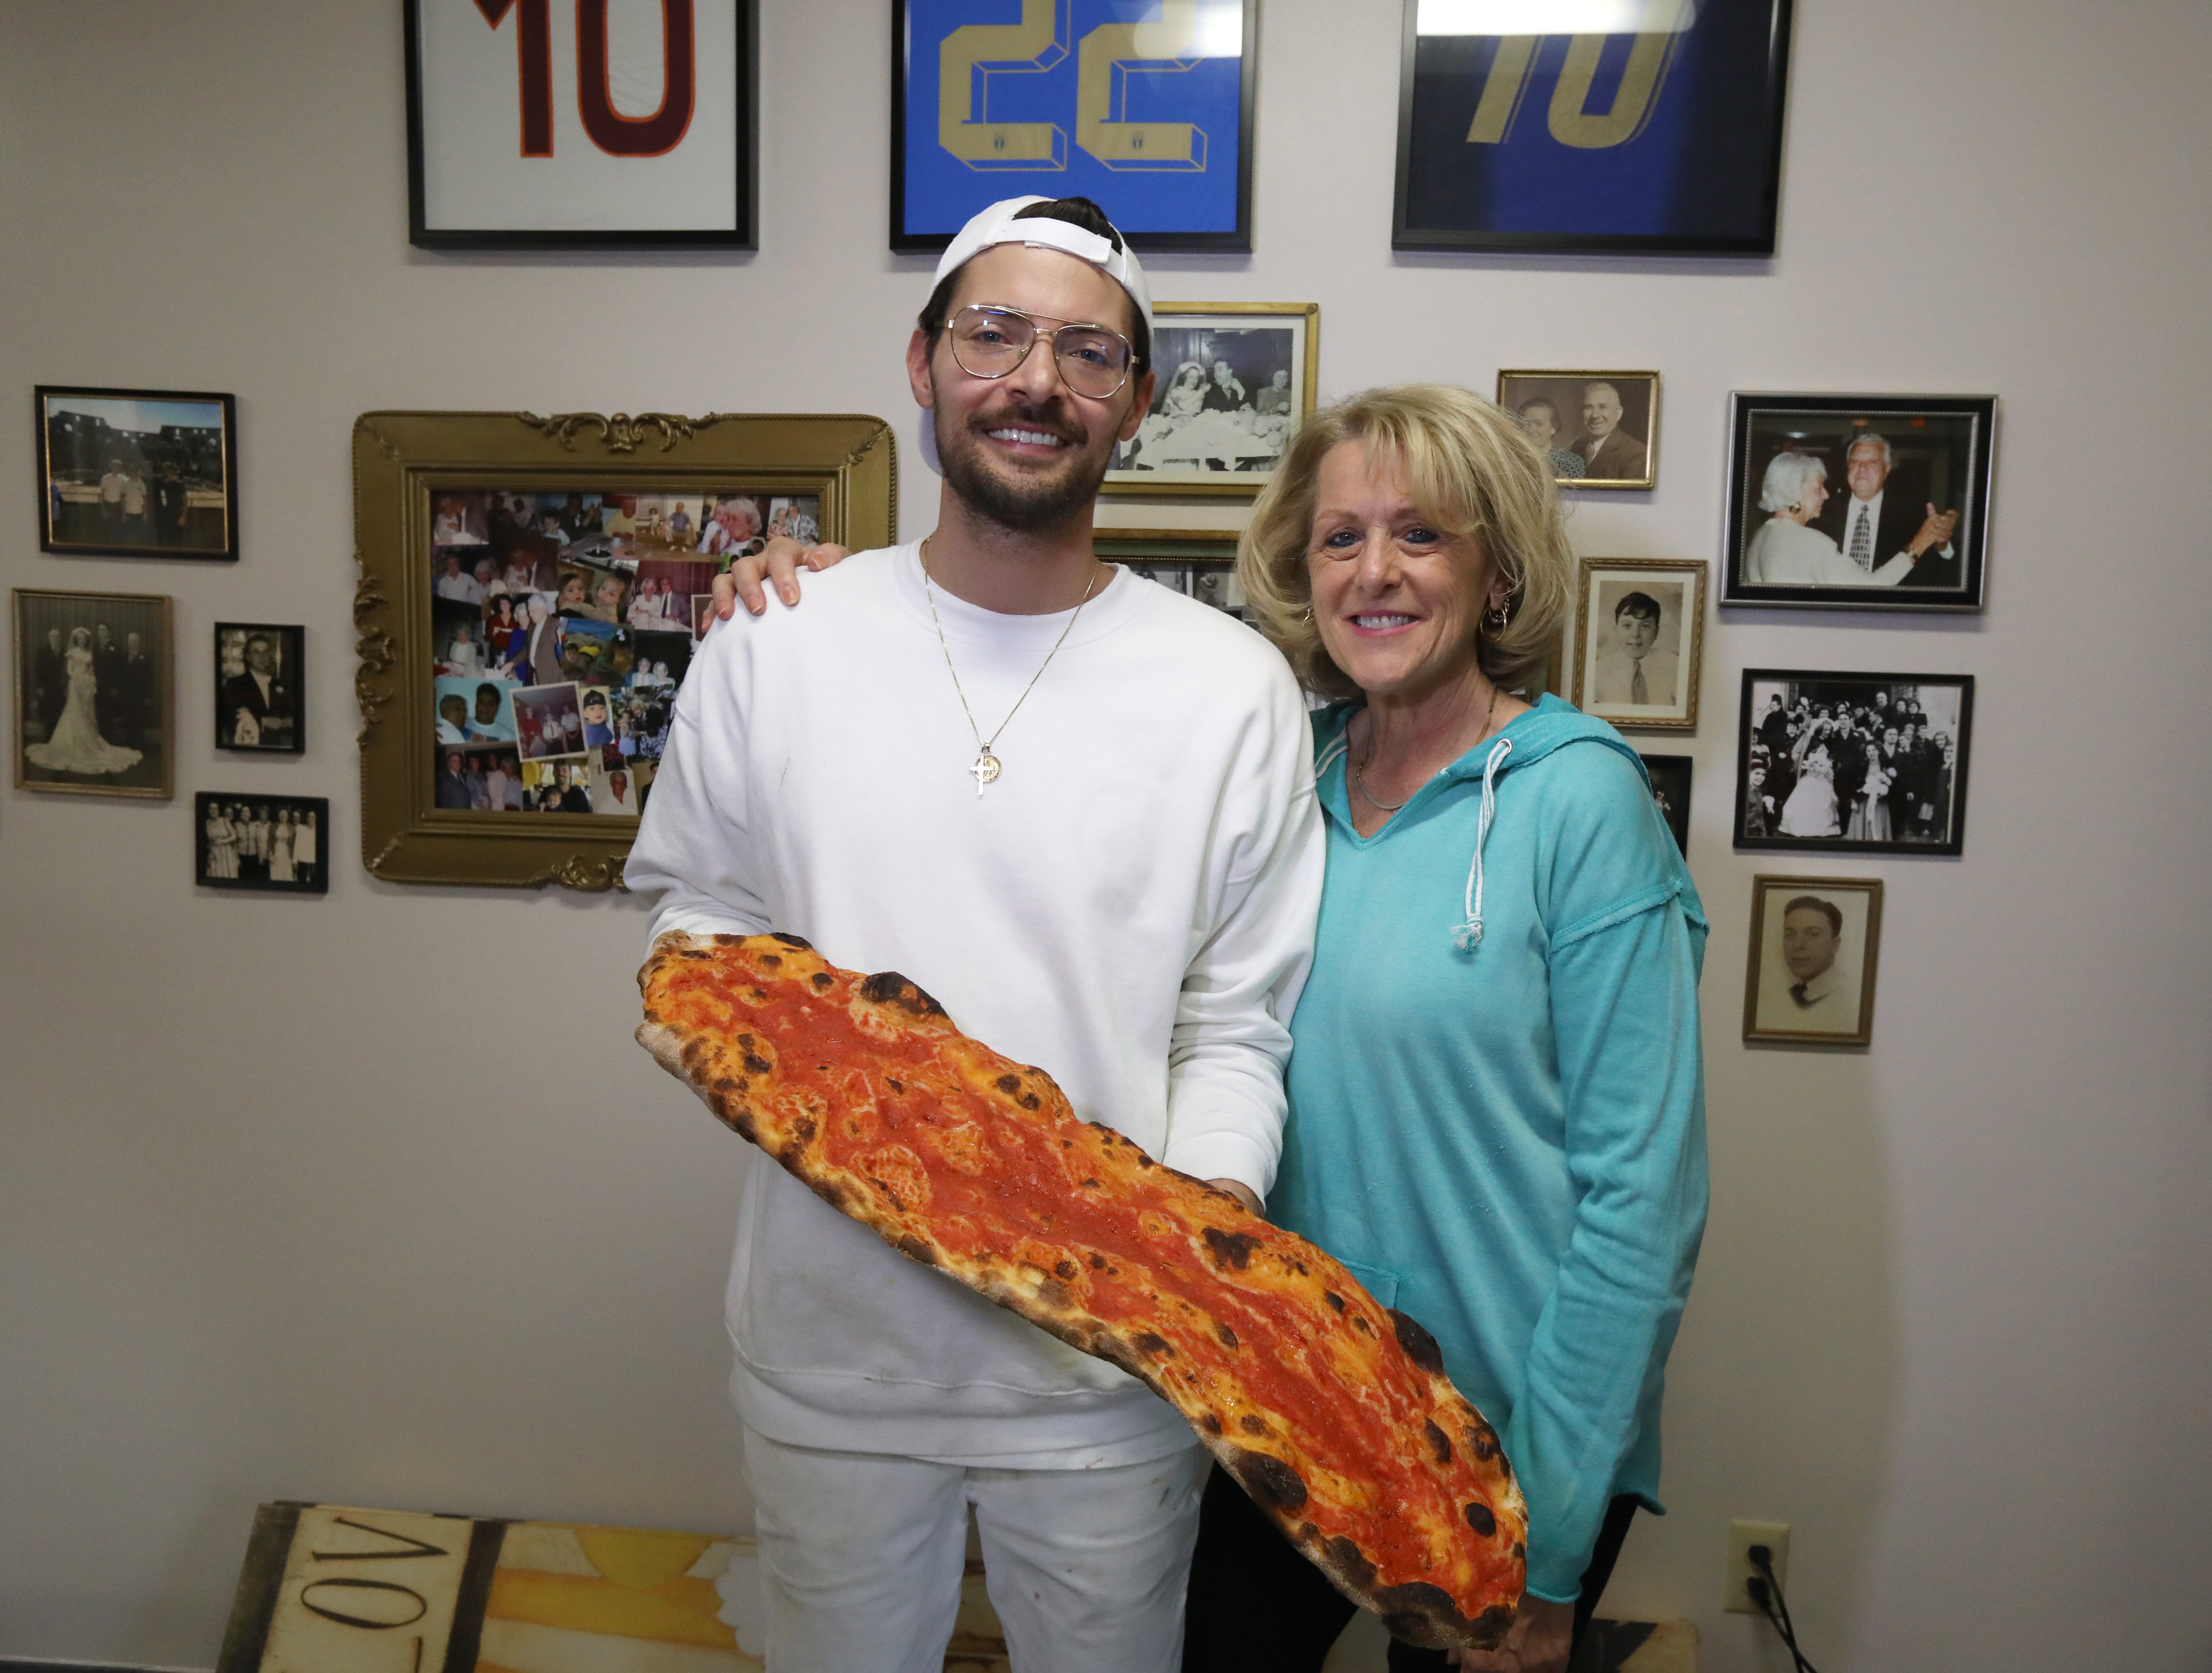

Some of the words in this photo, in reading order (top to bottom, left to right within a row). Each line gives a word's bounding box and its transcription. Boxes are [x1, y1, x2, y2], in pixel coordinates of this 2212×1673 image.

[472, 0, 695, 158] 10
[939, 0, 1207, 172] 22
[301, 1516, 449, 1673] OV
